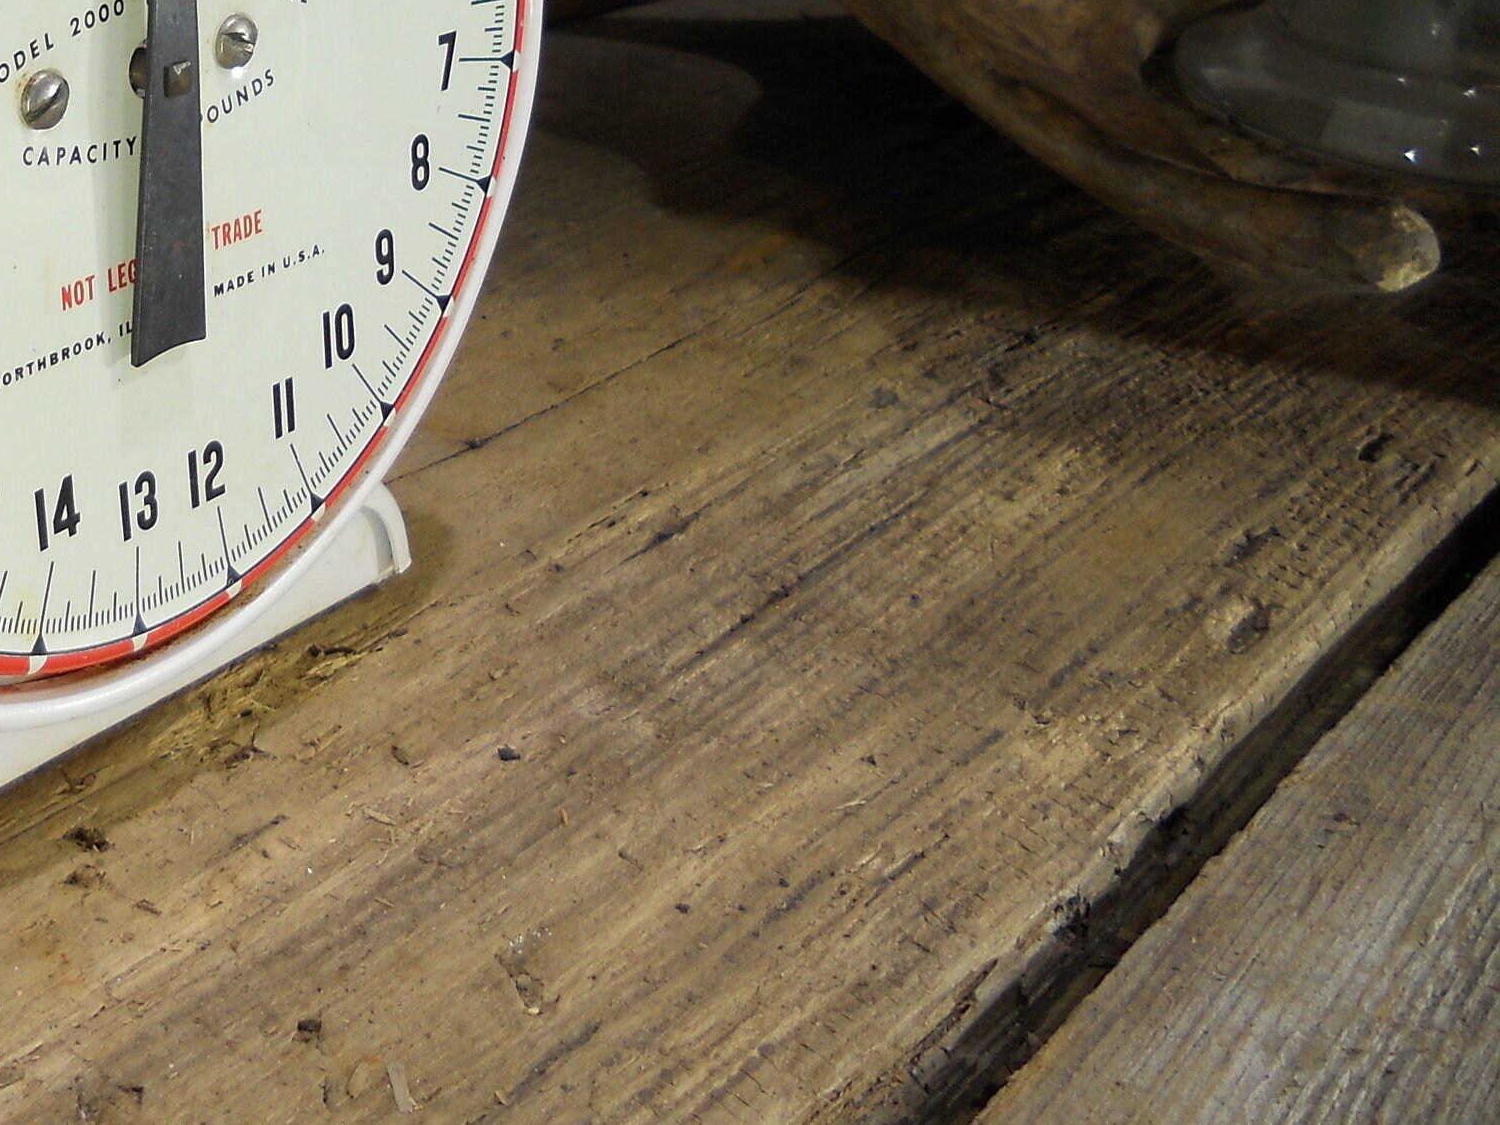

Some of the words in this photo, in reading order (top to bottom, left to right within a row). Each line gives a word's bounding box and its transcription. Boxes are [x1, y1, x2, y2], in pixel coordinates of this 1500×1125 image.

[438, 31, 457, 91] 7
[22, 136, 138, 167] CAPACITY
[200, 69, 275, 124] OUNDS
[411, 135, 429, 190] 8
[61, 274, 97, 312] NOT
[211, 209, 263, 251] TRADE
[213, 270, 255, 298] MADE
[261, 261, 277, 279] IN
[283, 244, 325, 269] U.S.A.
[375, 229, 394, 285] 9
[323, 303, 355, 369] 10
[272, 377, 296, 439] 11
[118, 471, 158, 542] 13
[188, 441, 226, 509] 12
[34, 473, 81, 552] 14
